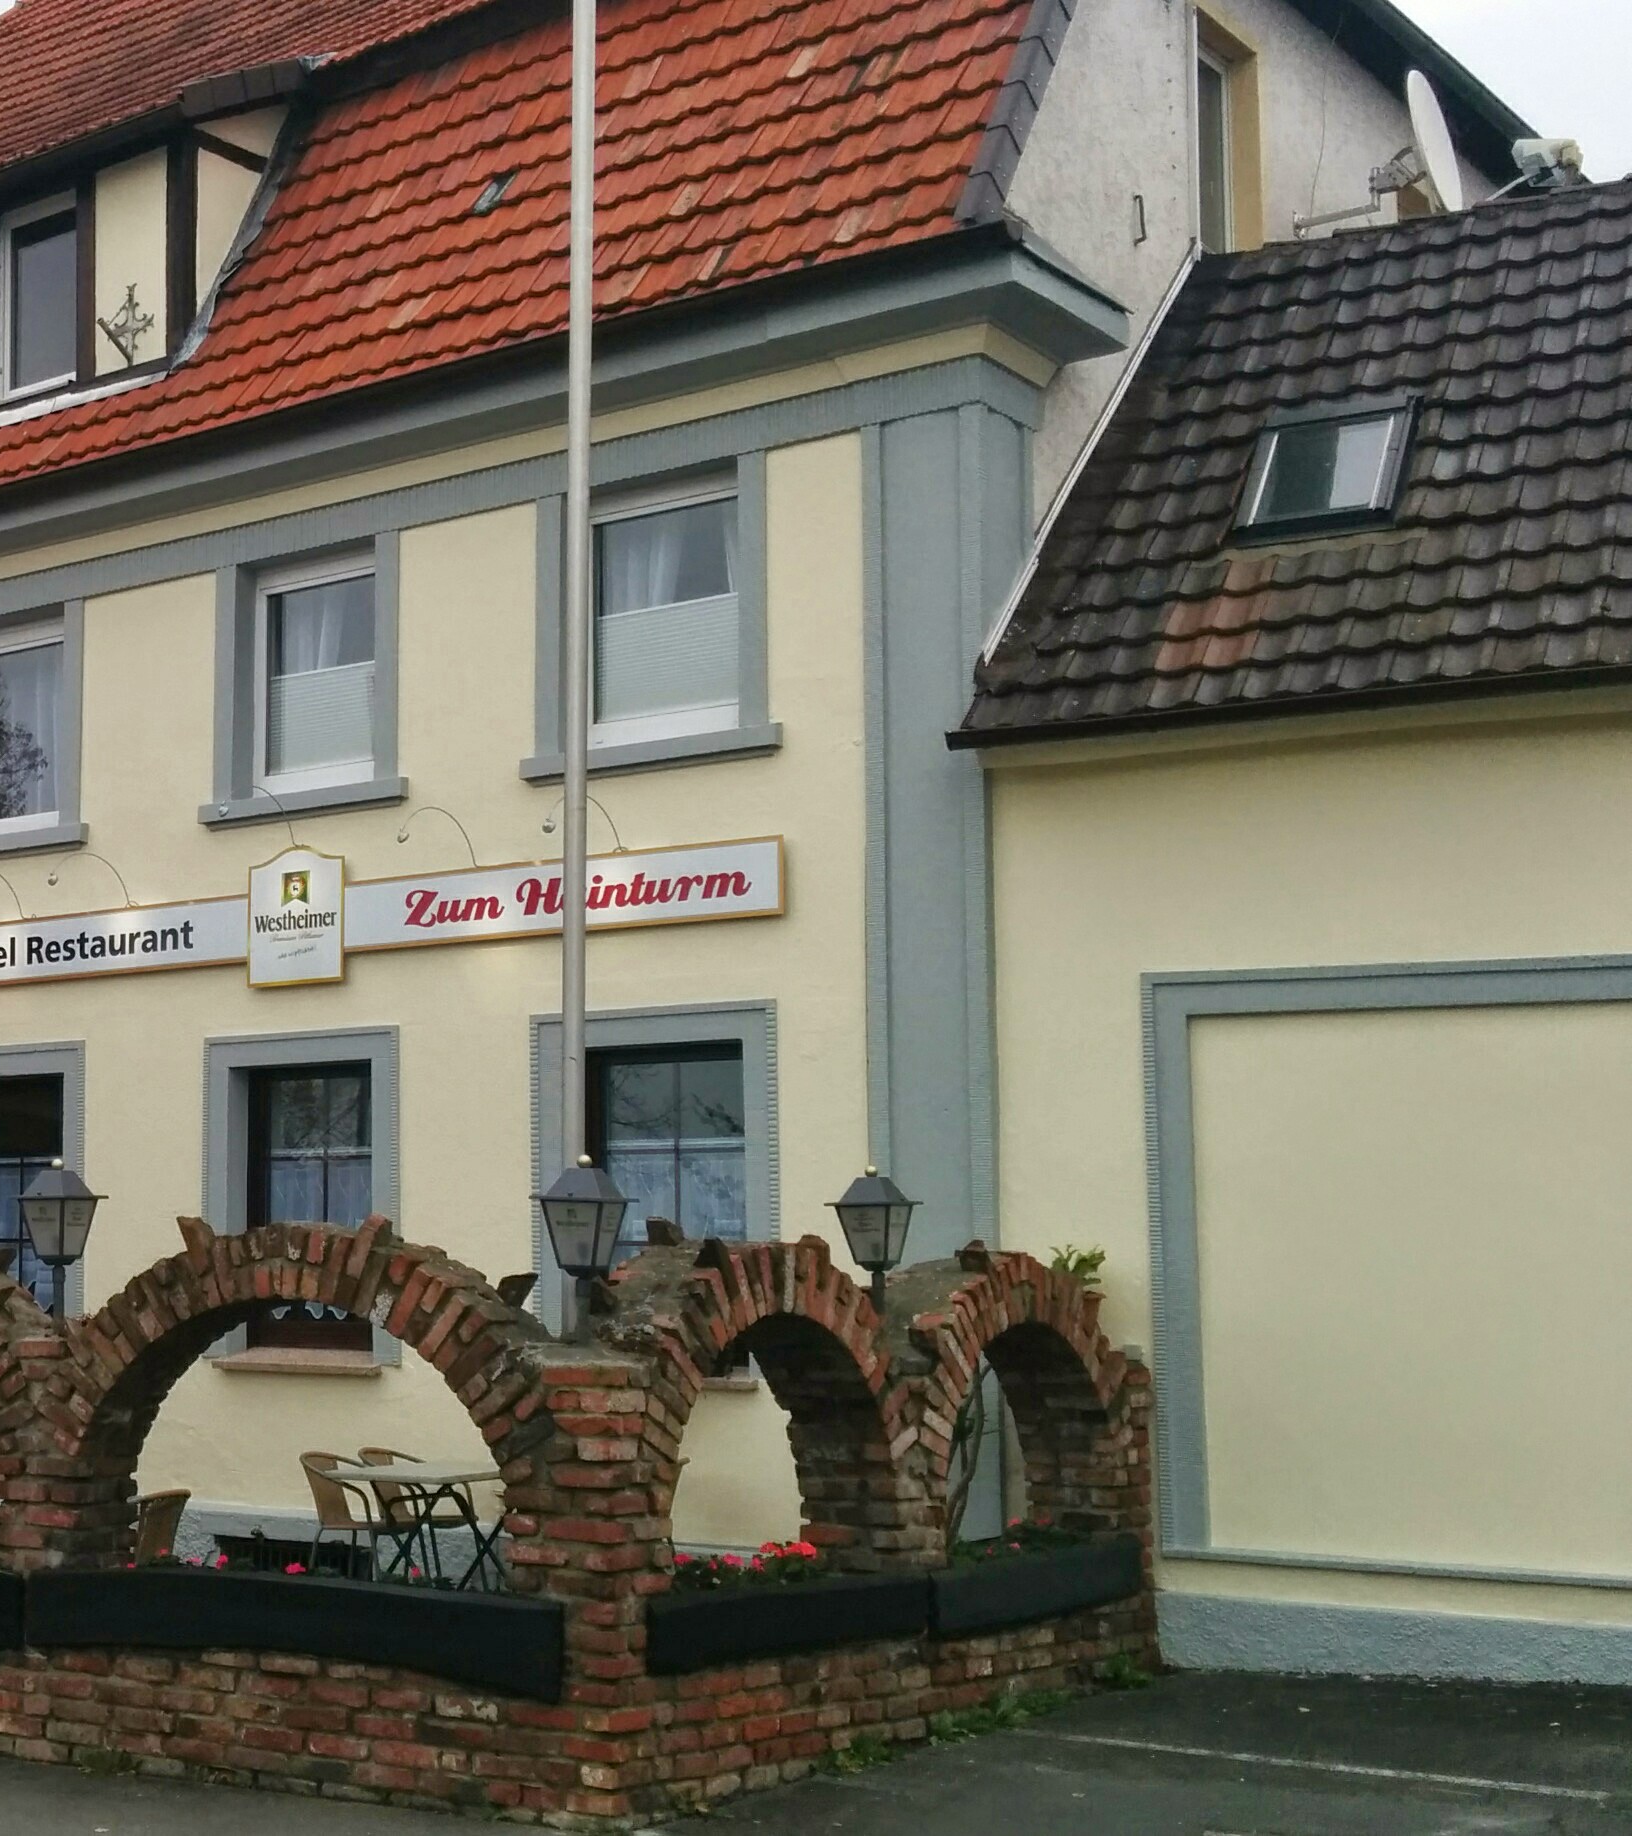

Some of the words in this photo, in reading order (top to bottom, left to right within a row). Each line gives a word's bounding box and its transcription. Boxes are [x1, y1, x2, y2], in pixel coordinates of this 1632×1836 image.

[404, 889, 505, 927] Zum
[516, 870, 752, 915] Hinturm
[26, 920, 194, 964] Restaurant
[254, 909, 337, 933] Westheimer
